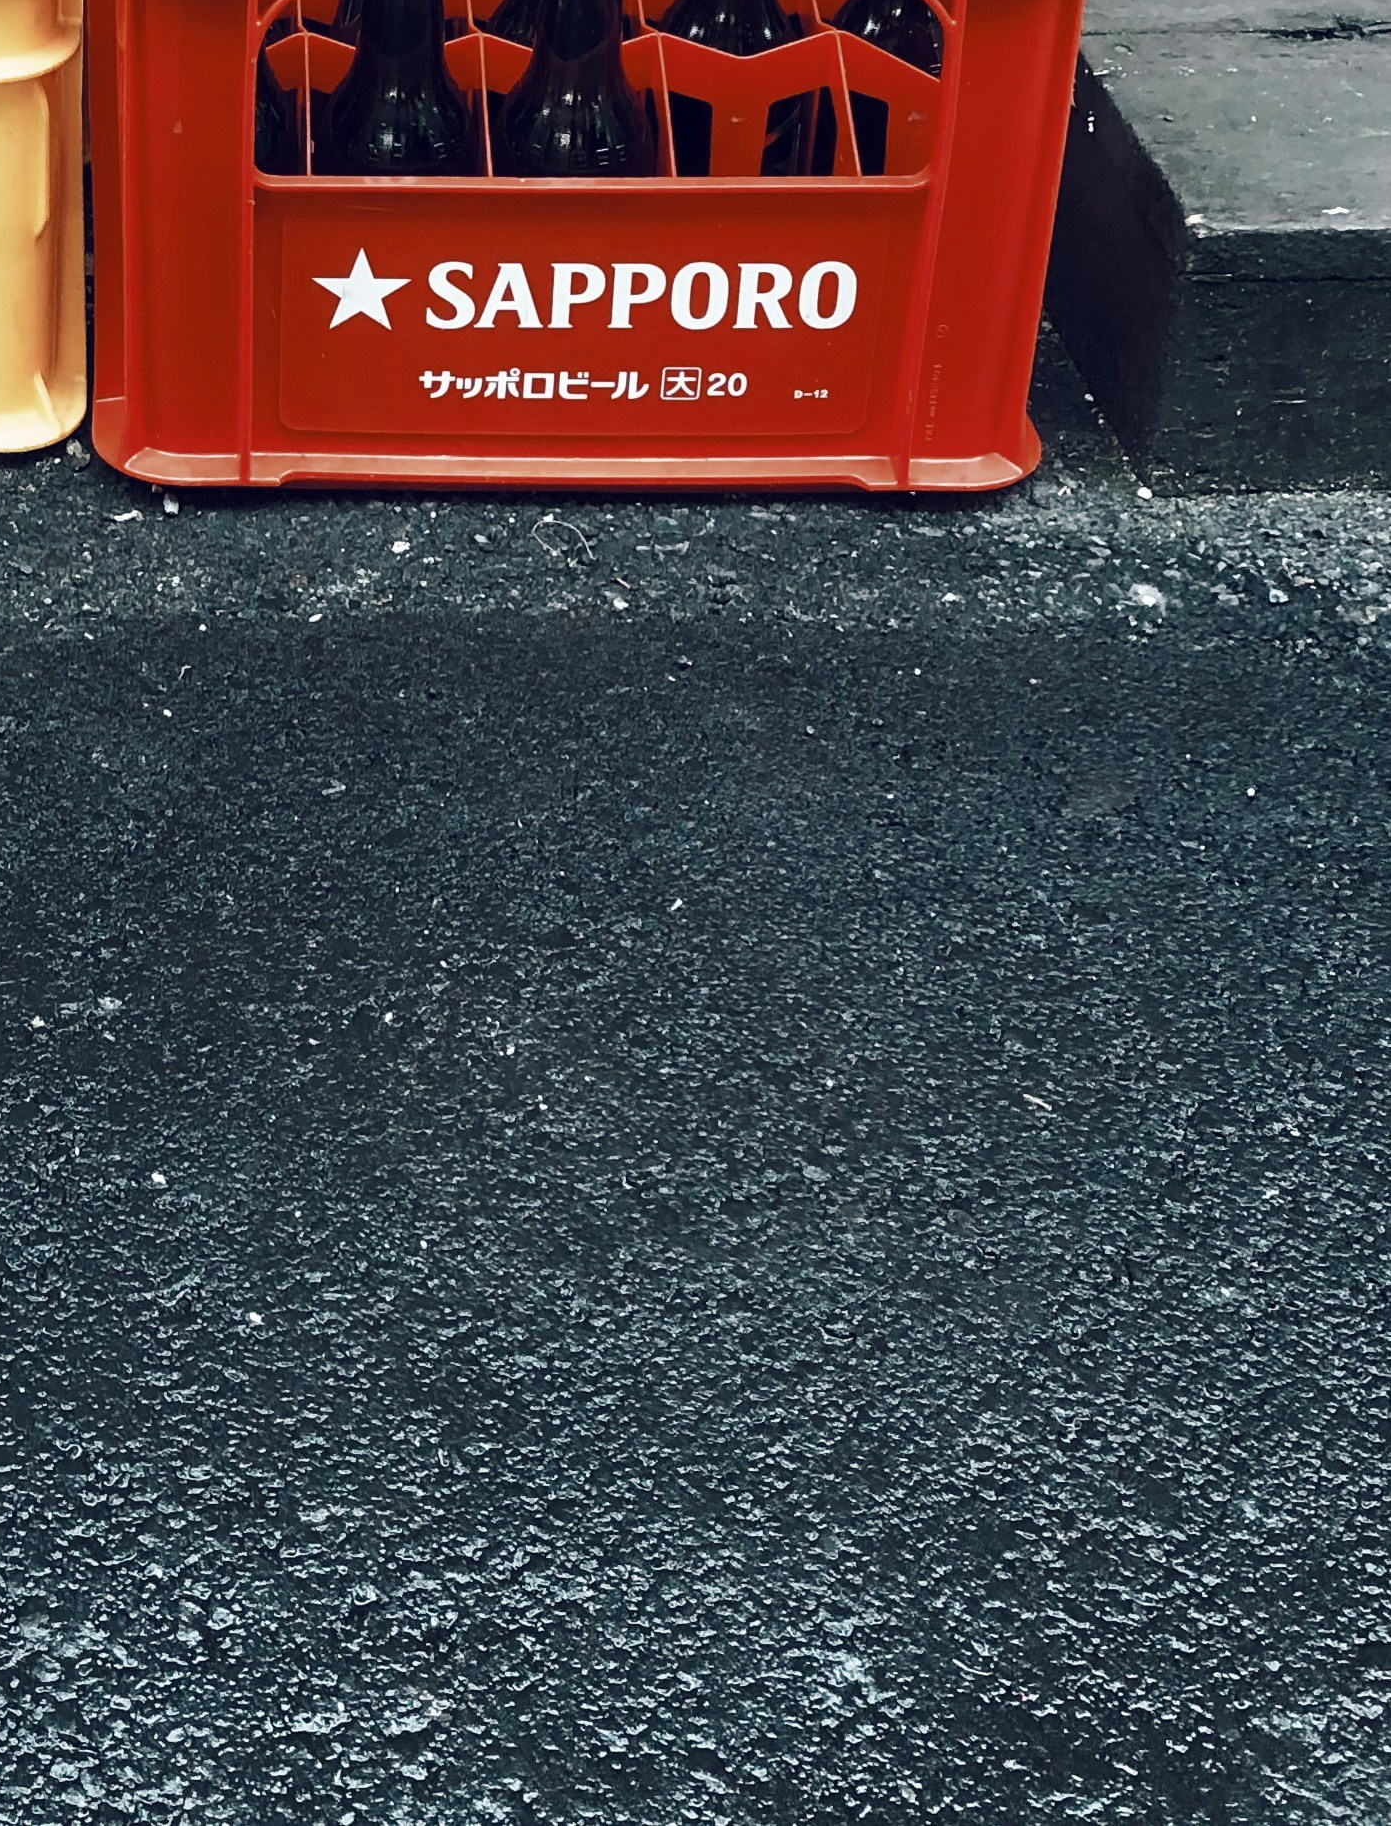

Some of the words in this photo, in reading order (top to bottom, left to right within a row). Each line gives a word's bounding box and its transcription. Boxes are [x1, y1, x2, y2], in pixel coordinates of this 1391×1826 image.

[426, 261, 858, 330] SAPPORO
[419, 368, 649, 400] サッポロビール
[707, 373, 748, 397] 20
